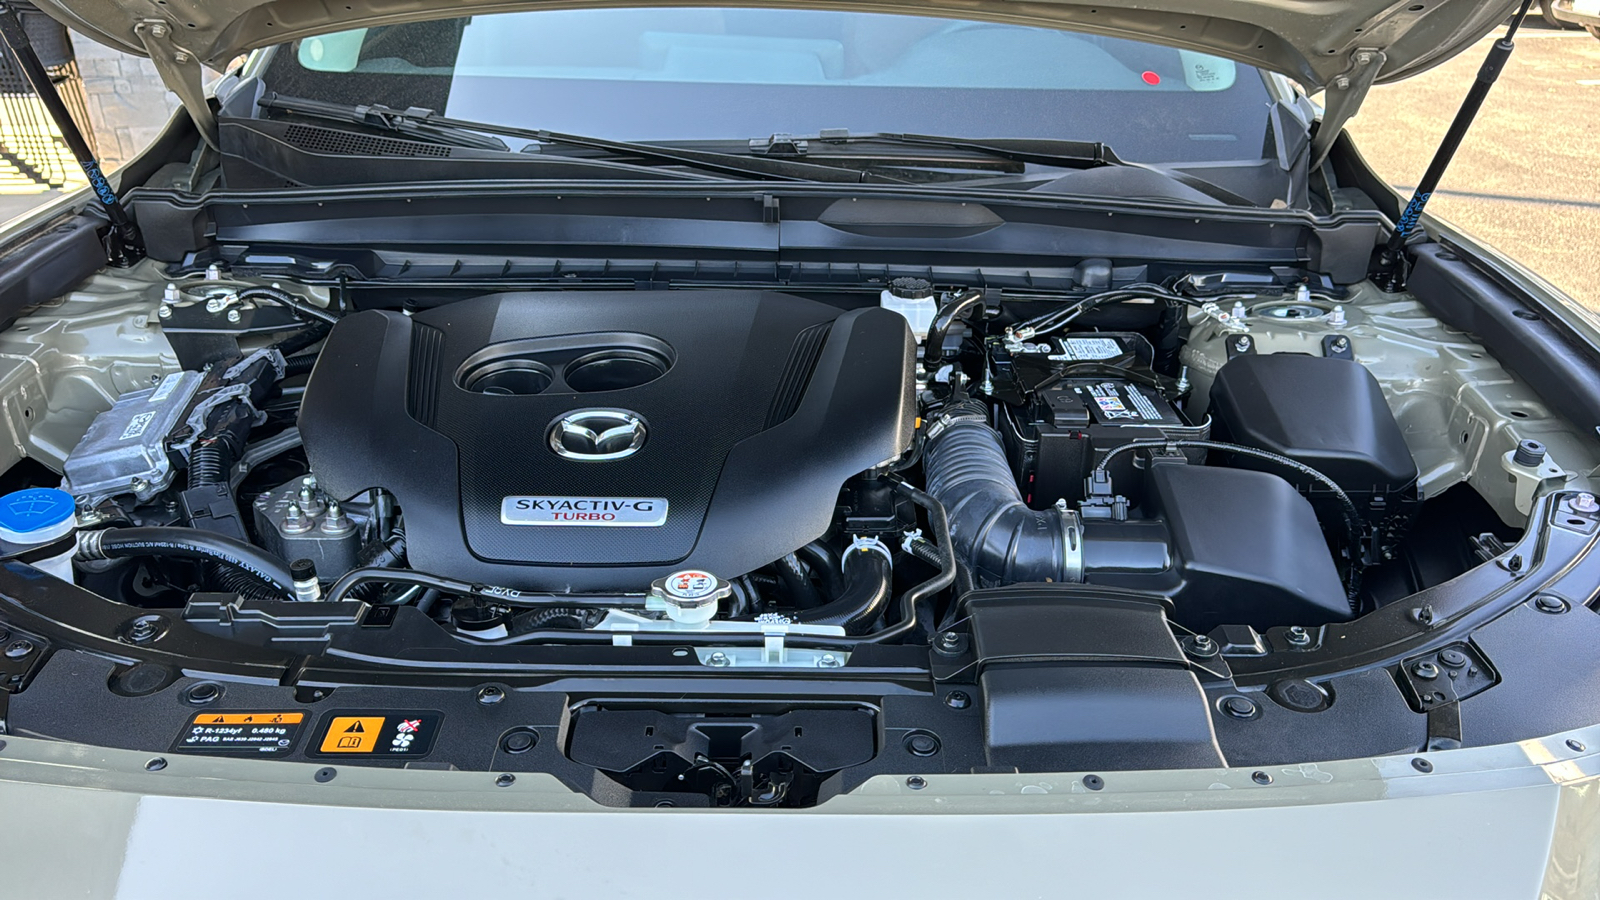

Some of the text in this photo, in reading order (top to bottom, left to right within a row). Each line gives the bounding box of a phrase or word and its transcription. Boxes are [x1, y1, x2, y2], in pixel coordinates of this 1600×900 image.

[516, 500, 653, 511] SKYACTIV-G
[551, 512, 616, 521] TURBO
[239, 561, 272, 583] GALAXY
